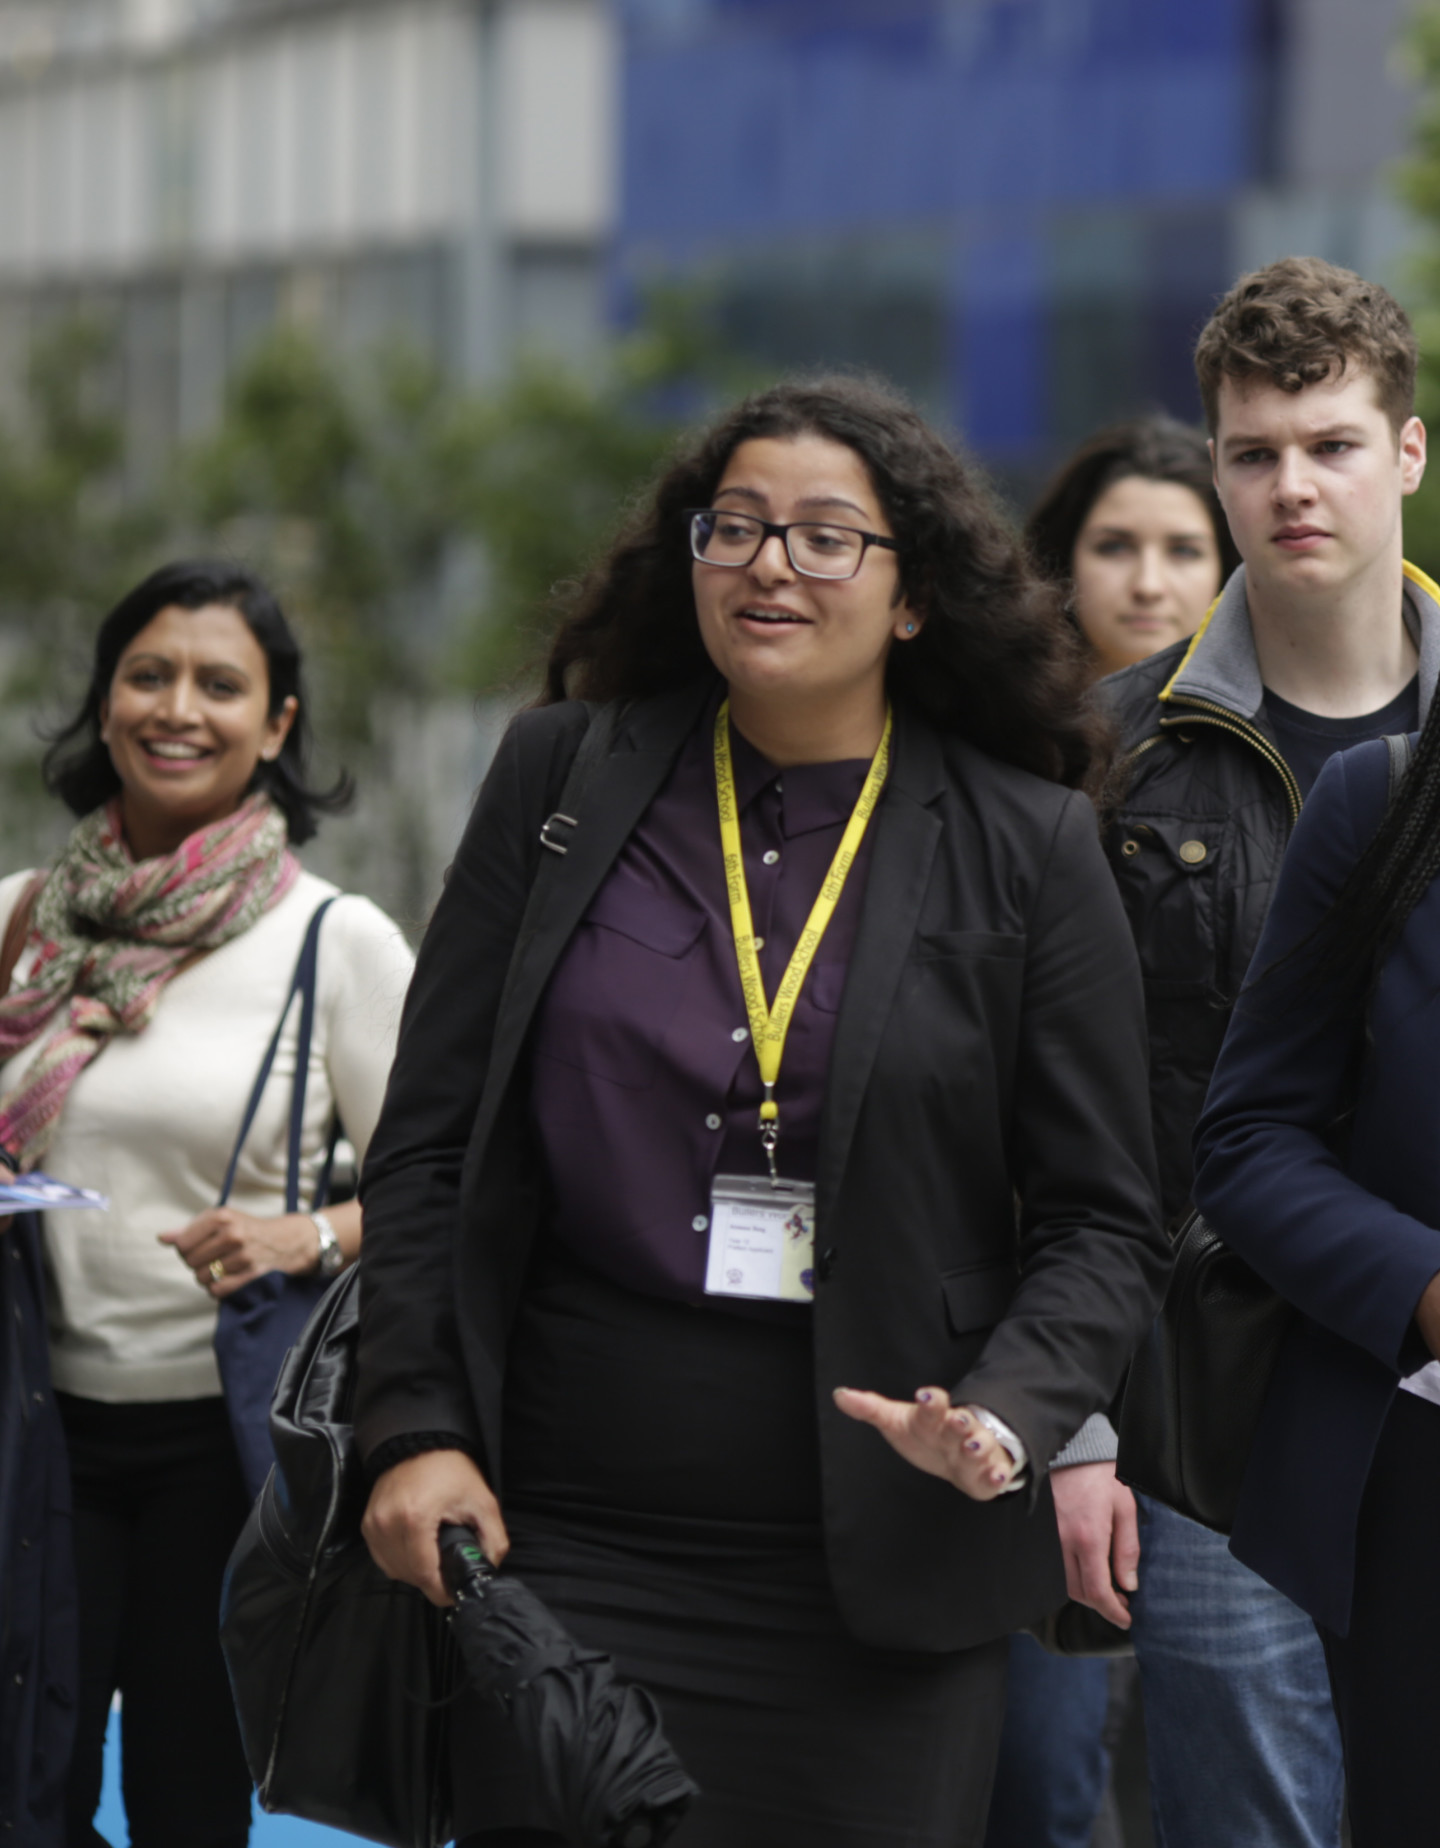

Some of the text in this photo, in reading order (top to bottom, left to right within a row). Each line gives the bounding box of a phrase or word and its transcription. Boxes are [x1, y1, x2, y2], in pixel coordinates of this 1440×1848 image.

[718, 783, 735, 823] School
[725, 853, 742, 906] 6th Form
[822, 850, 853, 902] 6th Form
[736, 935, 753, 973] Bullers
[742, 974, 763, 1010] Wood
[766, 928, 820, 1042] Bullers Wood School
